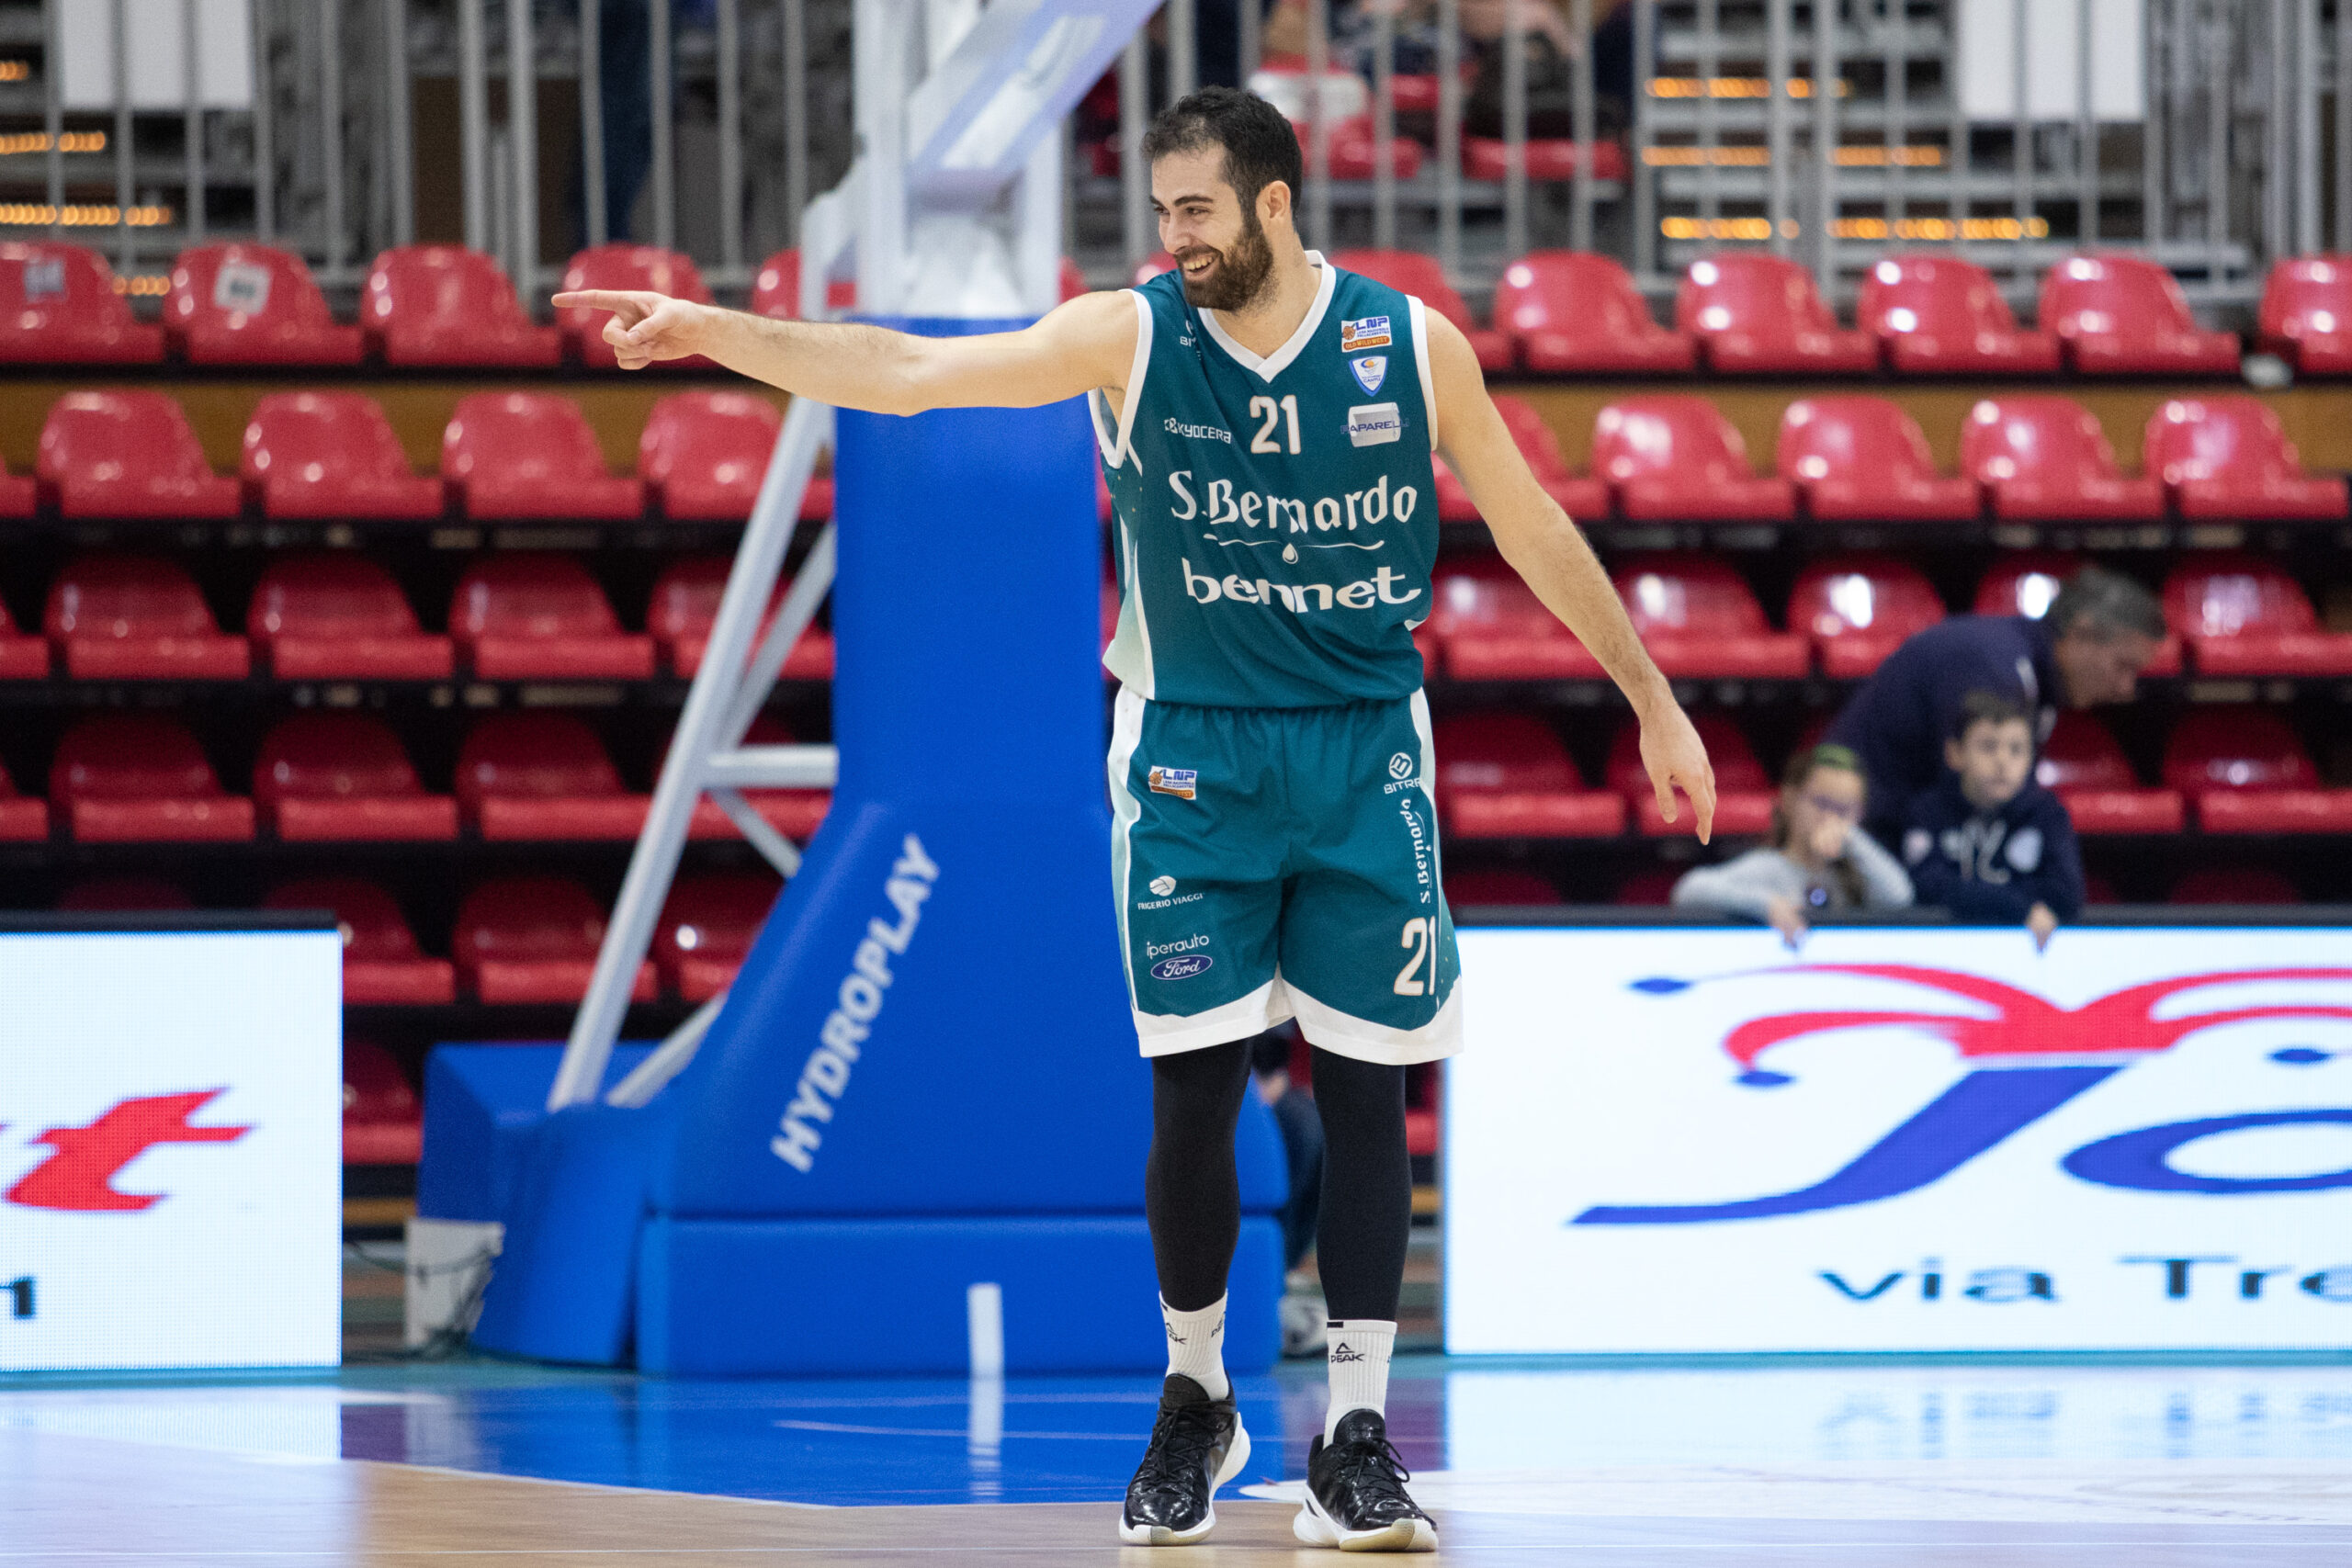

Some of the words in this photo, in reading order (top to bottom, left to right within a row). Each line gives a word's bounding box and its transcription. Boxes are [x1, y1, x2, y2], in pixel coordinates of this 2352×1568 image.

[1355, 317, 1388, 331] LNP
[1177, 423, 1231, 444] KYOCERA
[1250, 395, 1301, 455] 21
[1182, 557, 1421, 614] bennet
[1162, 769, 1195, 781] LNP
[1137, 898, 1171, 910] FRIGERIO
[1172, 893, 1204, 905] VIAGGI
[1147, 933, 1210, 960] iperauto
[1394, 916, 1437, 996] 21
[1162, 958, 1201, 977] Ford
[770, 833, 941, 1173] HYDROPLAY
[1814, 1257, 2061, 1304] via
[1330, 1353, 1365, 1363] PEAK
